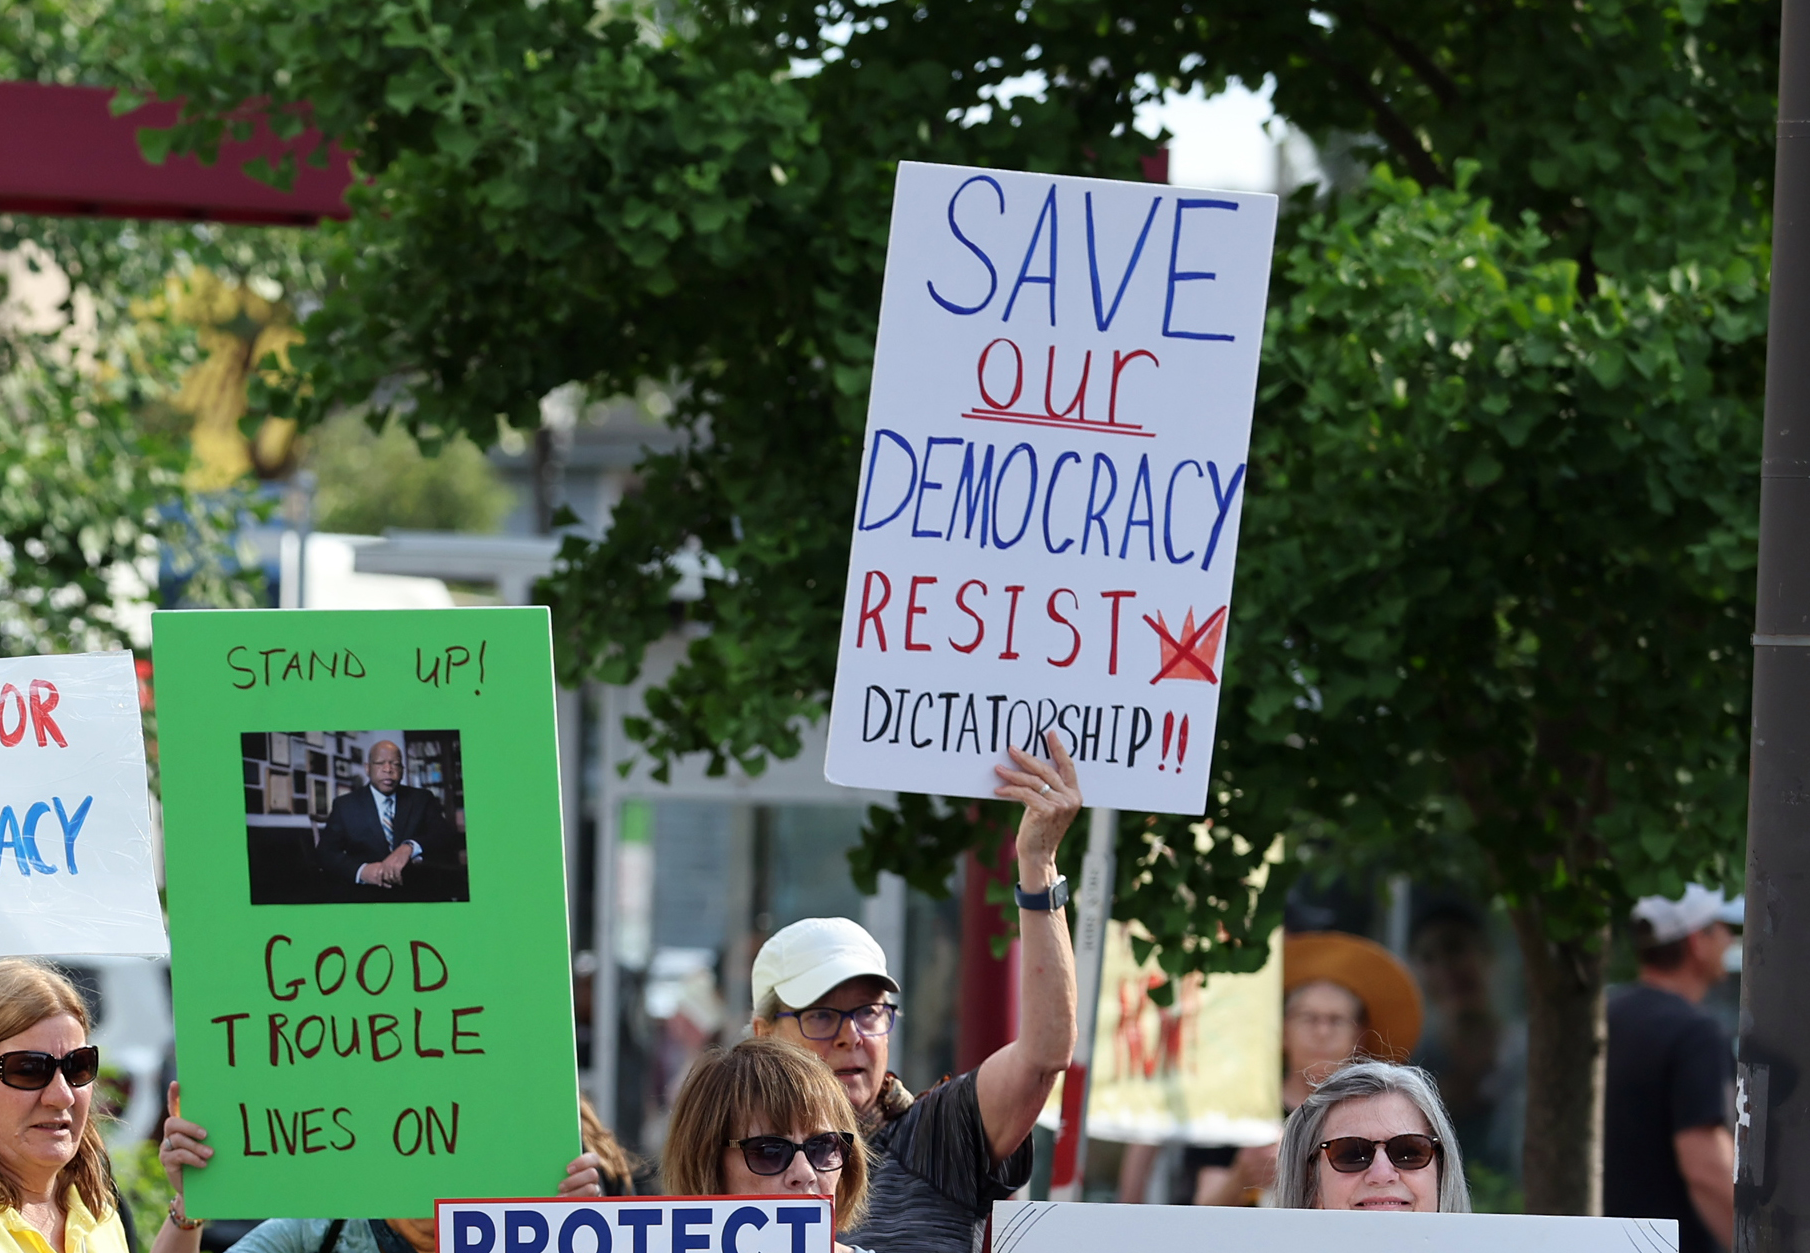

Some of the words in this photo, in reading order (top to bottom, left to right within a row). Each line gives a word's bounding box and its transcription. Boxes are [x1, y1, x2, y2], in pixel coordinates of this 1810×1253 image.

[927, 175, 1239, 342] SAVE
[858, 429, 1246, 571] DEMOCRACY
[857, 571, 1137, 676] RESIST
[227, 646, 367, 690] STAND
[416, 641, 487, 696] UP!
[265, 934, 448, 1001] GOOD
[211, 1007, 486, 1067] TROUBLE
[239, 1102, 356, 1156] LIVES
[393, 1103, 459, 1155] ON
